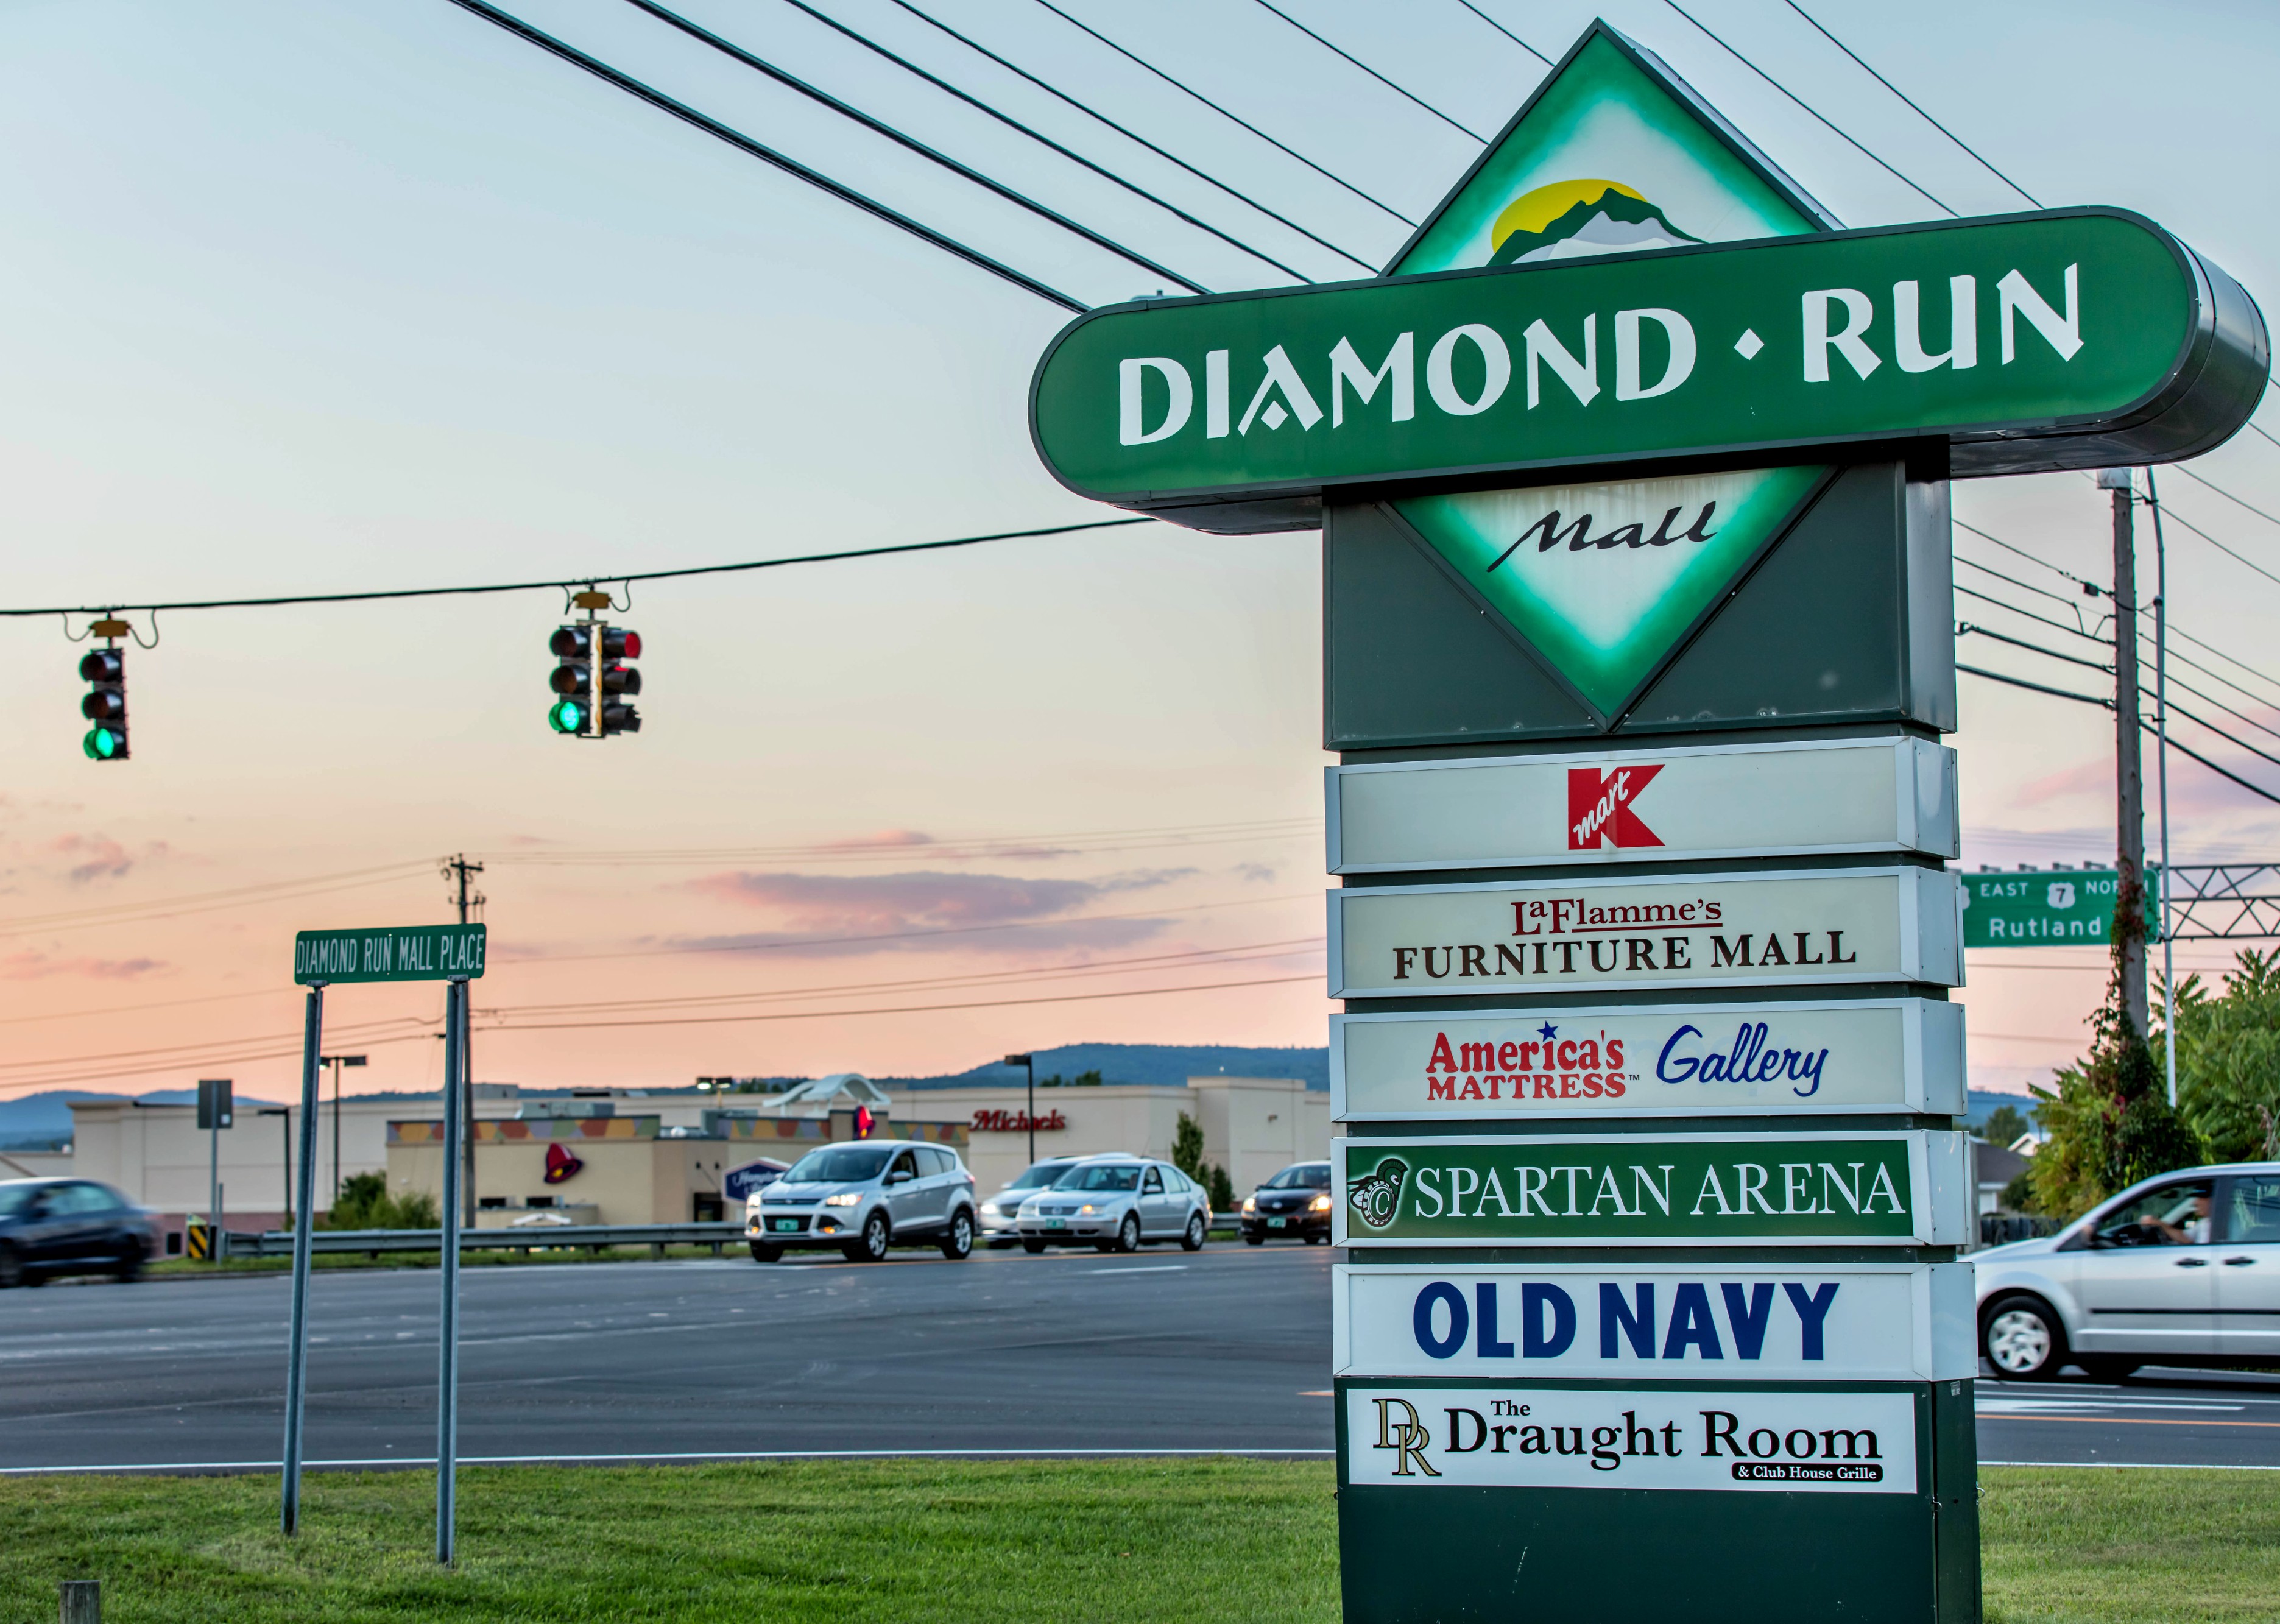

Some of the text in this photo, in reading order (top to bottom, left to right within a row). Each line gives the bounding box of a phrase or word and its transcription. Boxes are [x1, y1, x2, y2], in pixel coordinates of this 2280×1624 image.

[1119, 263, 2084, 446] DIAMOND RUN
[1487, 501, 1717, 573] Mall
[1981, 882, 2028, 897] EAST
[1511, 898, 1721, 936] LaFlamme's
[1990, 916, 2102, 937] Rutland
[296, 934, 484, 974] DIAMOND RUN MALL PLACE
[1393, 931, 1856, 979] FURNITURE MALL
[1426, 1029, 1624, 1073] America's
[1656, 1022, 1829, 1098] Gallery
[1427, 1071, 1626, 1101] MATTRESS
[1416, 1162, 1907, 1218] SPARTAN ARENA
[1413, 1281, 1840, 1360] OLD NAVY
[1490, 1399, 1531, 1416] The
[1444, 1408, 1883, 1471] Draught Room
[1738, 1465, 1877, 1480] & Club House Grille
